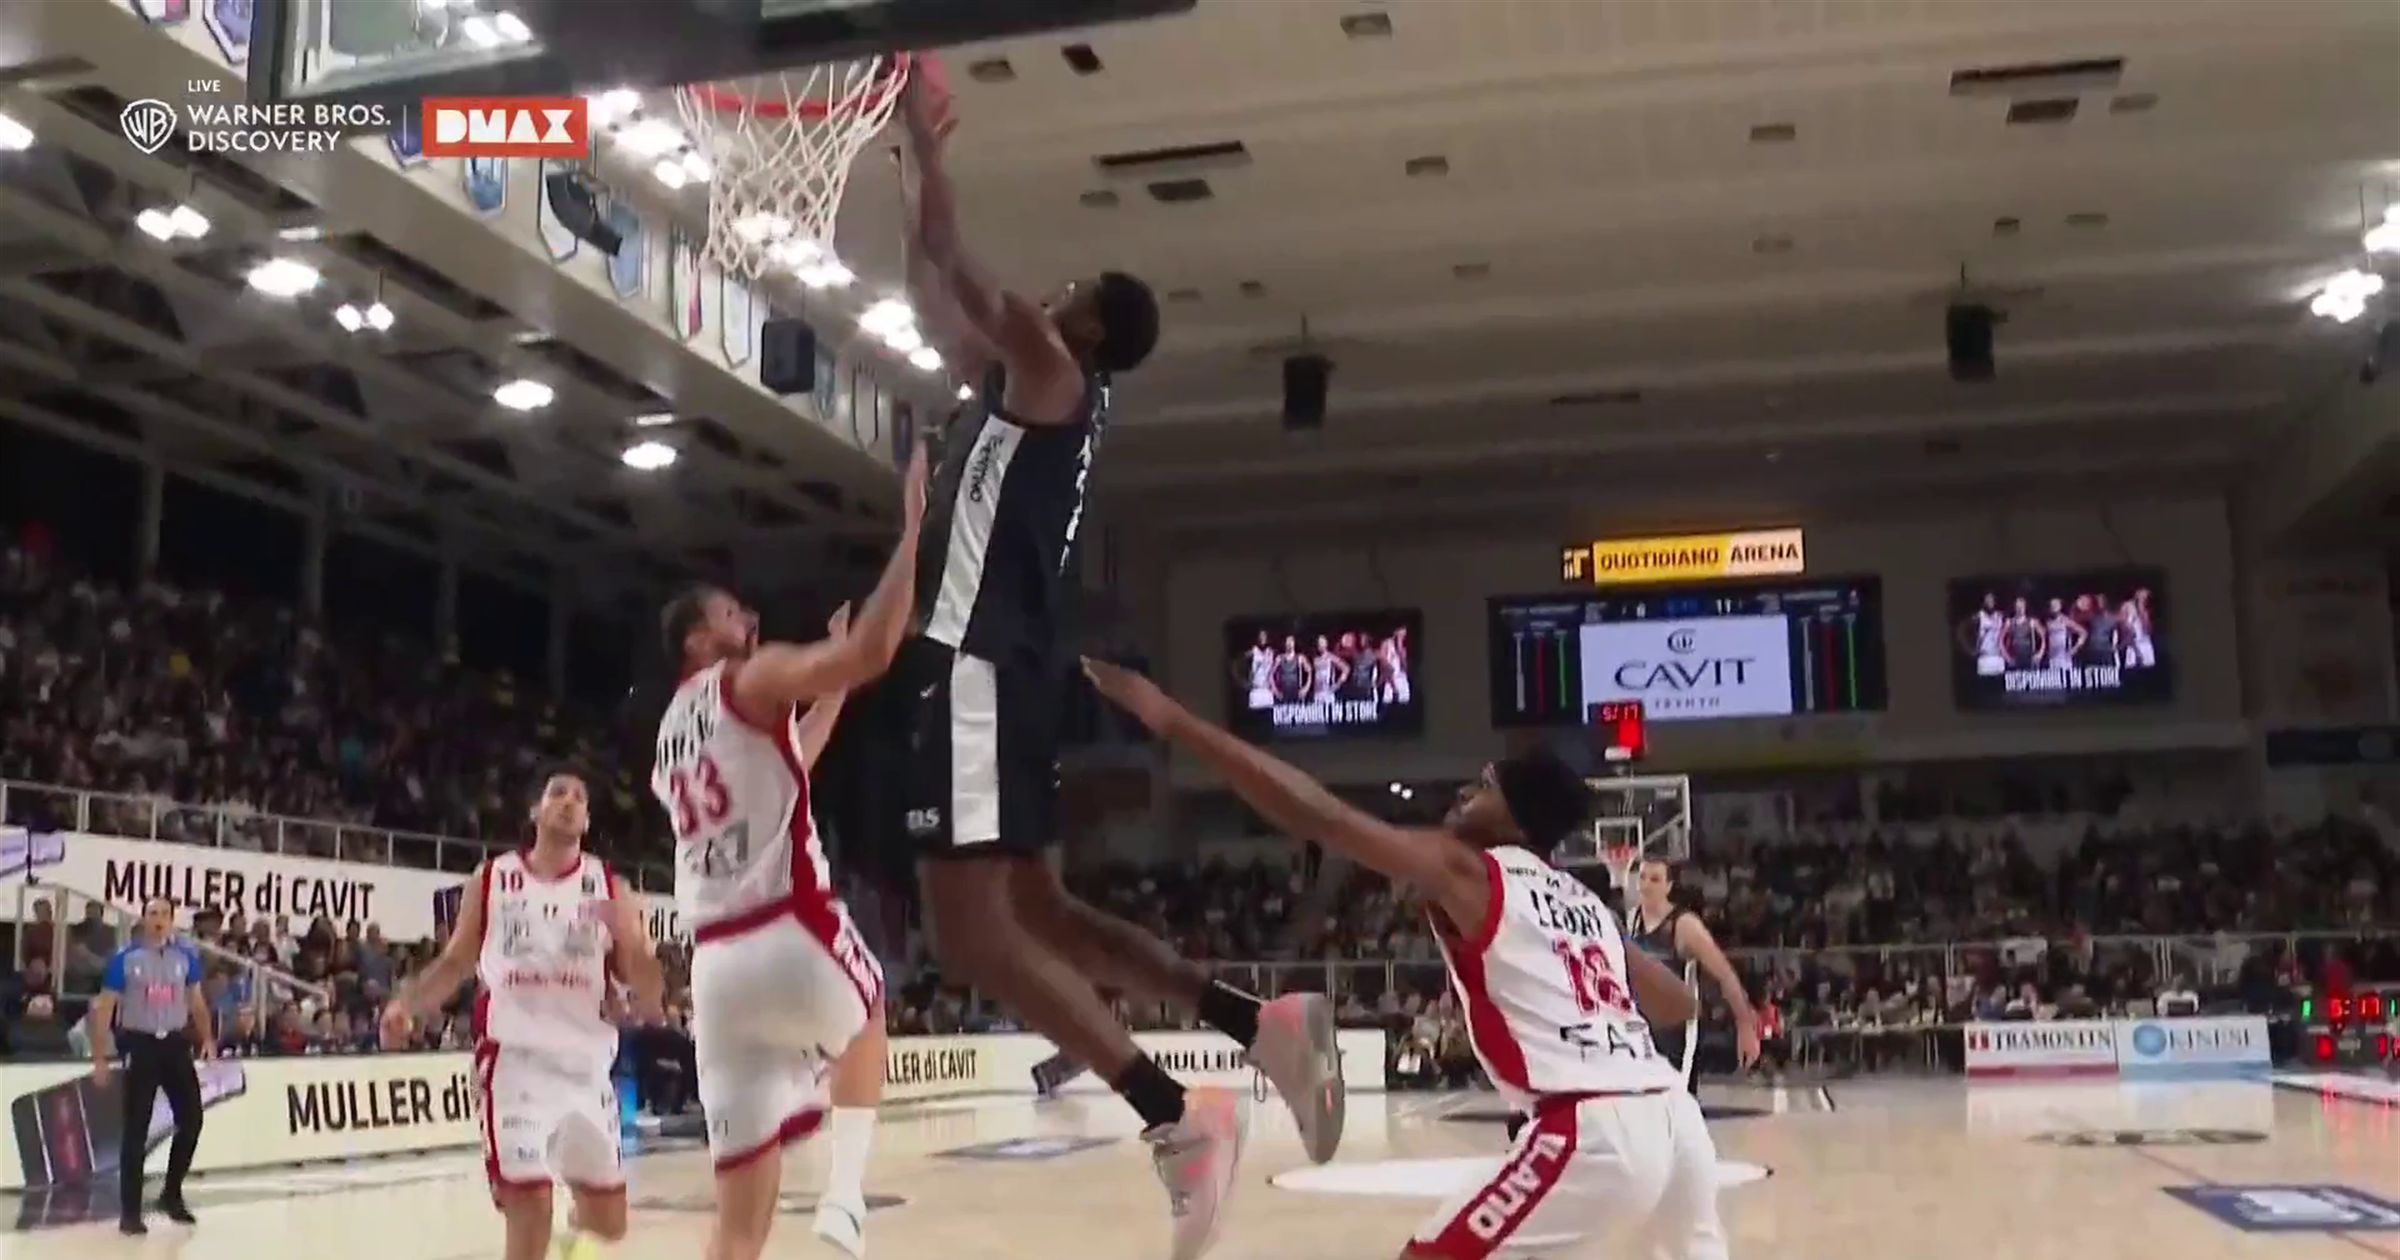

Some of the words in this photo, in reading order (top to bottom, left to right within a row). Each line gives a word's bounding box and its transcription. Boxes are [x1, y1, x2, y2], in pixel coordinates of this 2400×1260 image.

[1600, 546, 1719, 571] QUOTIDIANO
[1731, 542, 1800, 564] ARENA
[1614, 657, 1756, 691] CAVIT
[670, 753, 731, 840] 33
[104, 859, 246, 914] MULLER
[254, 870, 281, 914] di
[291, 874, 376, 919] CAVIT
[940, 1048, 977, 1080] CAVIT
[287, 1076, 434, 1135] MULLER
[442, 1072, 471, 1122] di
